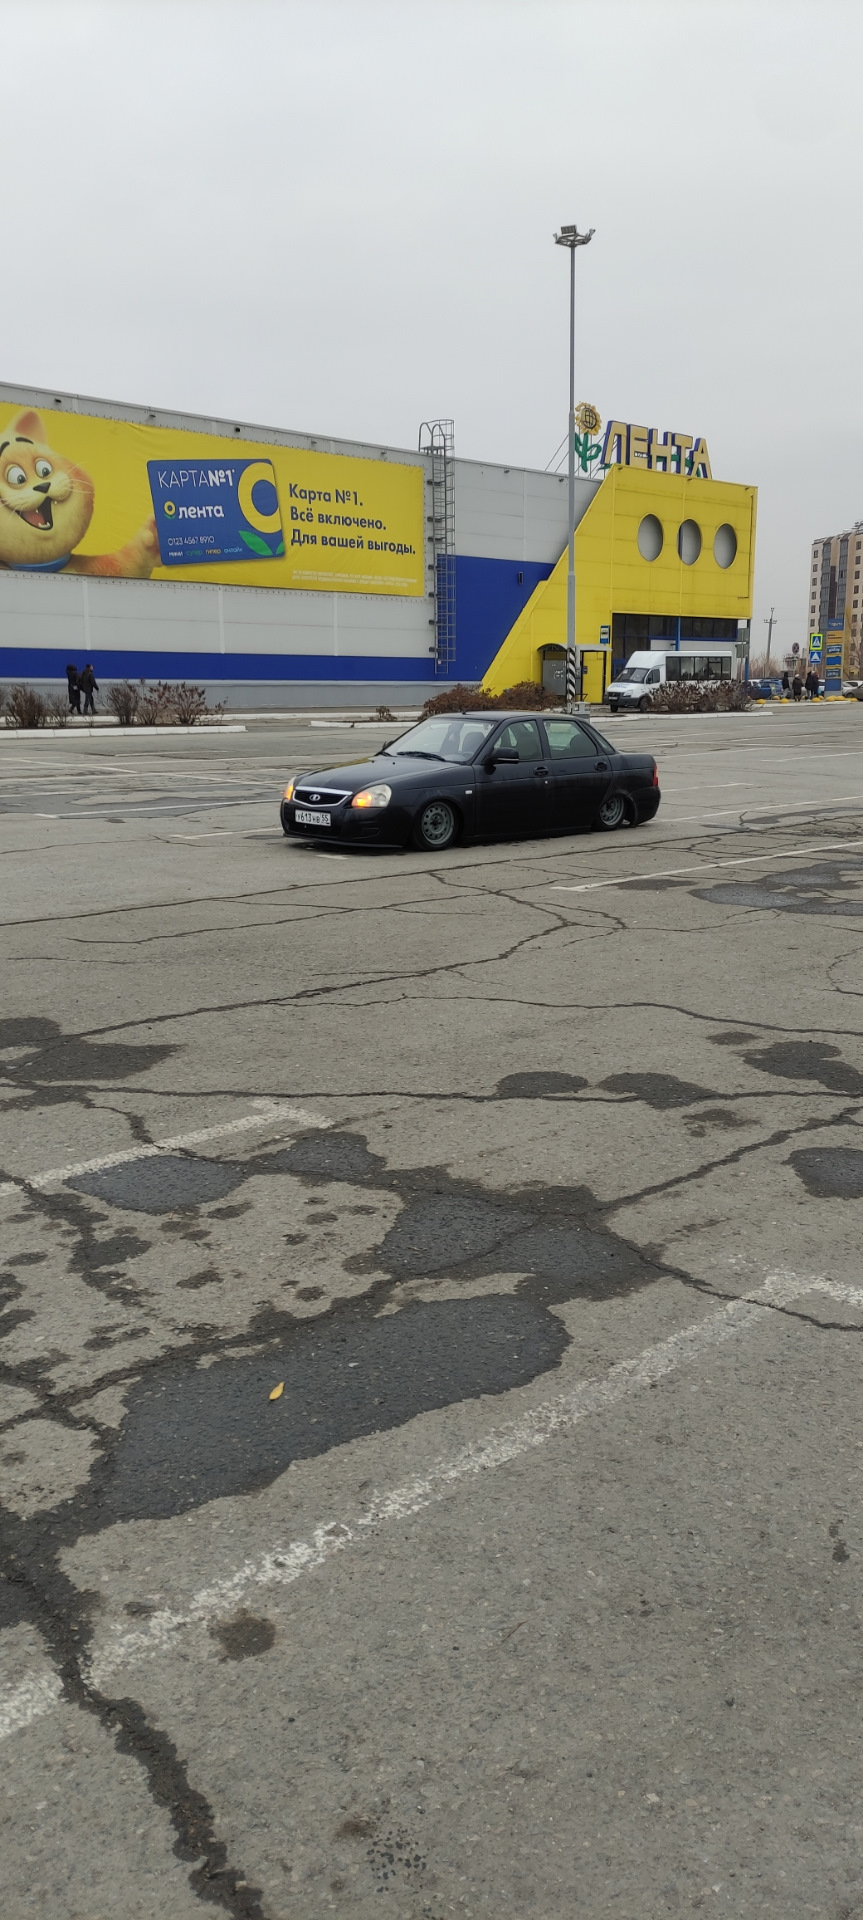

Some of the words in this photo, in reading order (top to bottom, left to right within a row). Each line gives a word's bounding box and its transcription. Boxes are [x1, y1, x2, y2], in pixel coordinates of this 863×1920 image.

[601, 420, 712, 479] ЛЕНТА
[289, 483, 332, 504] Карта
[335, 489, 363, 506] №1.
[178, 505, 225, 519] лента
[290, 506, 314, 522] Всё
[318, 513, 387, 530] включено.
[167, 537, 183, 546] 0123
[184, 536, 199, 545] 4567
[200, 535, 215, 544] 8910
[291, 528, 317, 546] Для
[321, 535, 364, 549] вашей
[368, 540, 416, 555] выгоды.
